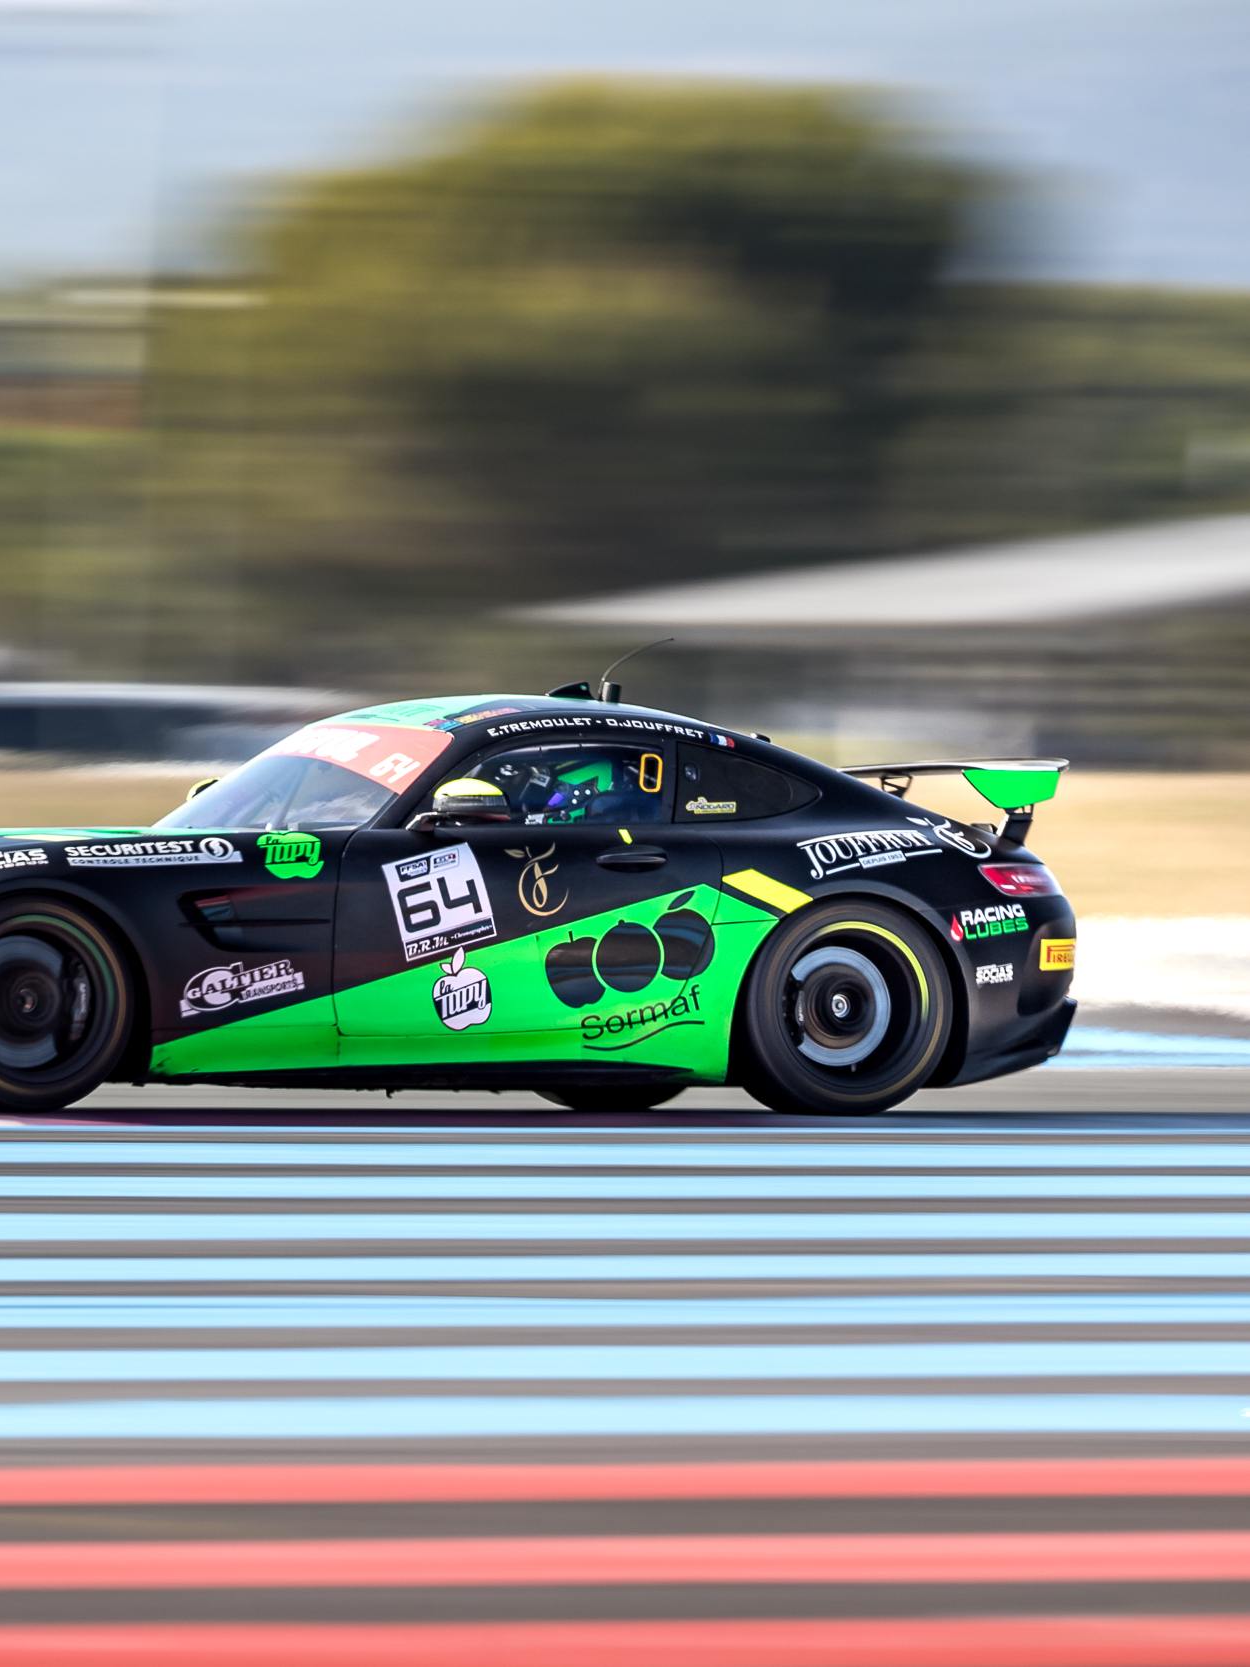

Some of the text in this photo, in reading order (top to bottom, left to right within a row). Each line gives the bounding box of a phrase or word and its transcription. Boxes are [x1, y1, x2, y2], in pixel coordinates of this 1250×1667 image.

[487, 718, 591, 737] E.TREMOULET
[605, 718, 705, 739] O.JOUFFRET
[369, 753, 421, 784] 64
[64, 840, 194, 857] SECURITEST
[134, 855, 200, 864] TECHNIQUE
[397, 876, 483, 934] 64
[960, 903, 1026, 927] RACING
[964, 917, 1030, 940] LUBES
[186, 960, 295, 999] GALTIER
[581, 984, 701, 1040] Sormaf
